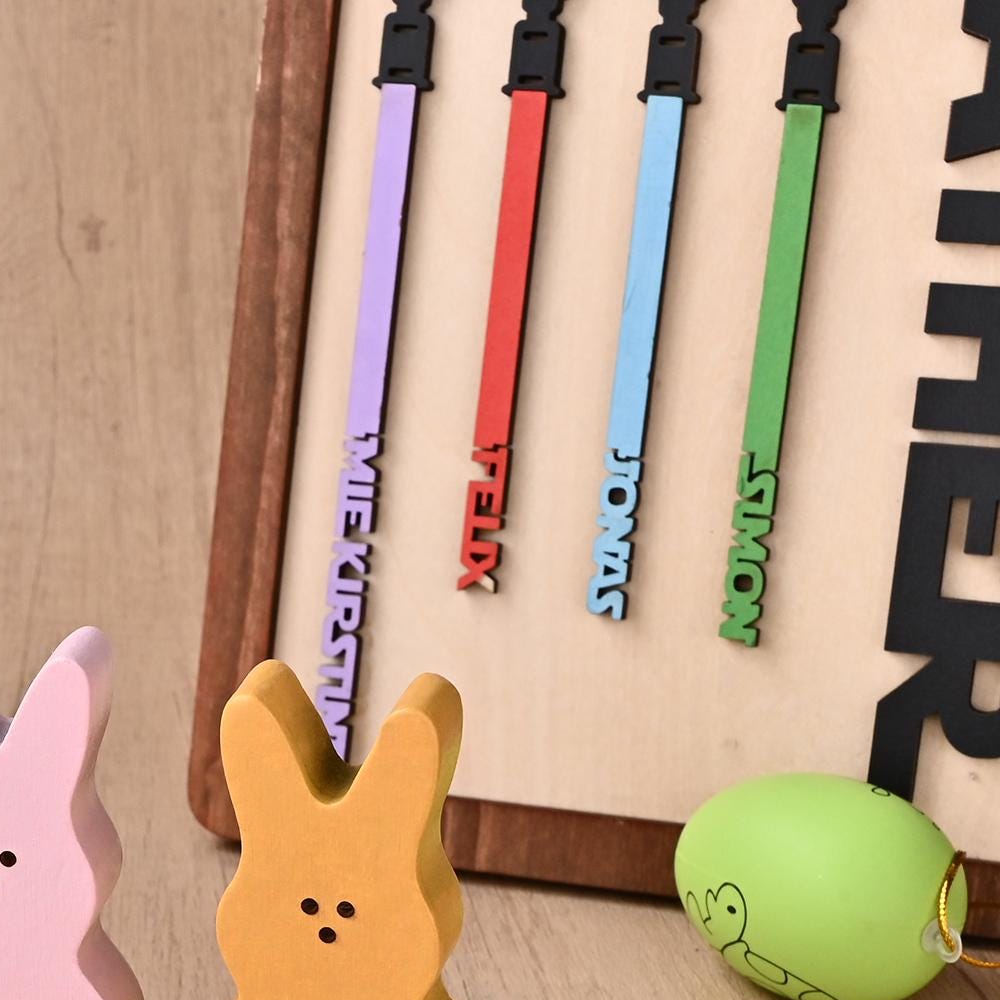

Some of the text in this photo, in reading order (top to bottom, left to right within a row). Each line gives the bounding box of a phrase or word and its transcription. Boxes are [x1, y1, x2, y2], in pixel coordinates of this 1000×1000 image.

[333, 437, 383, 538] MIE
[457, 447, 511, 593] FELIX
[586, 450, 643, 620] JONAS
[719, 454, 779, 648] SIMON
